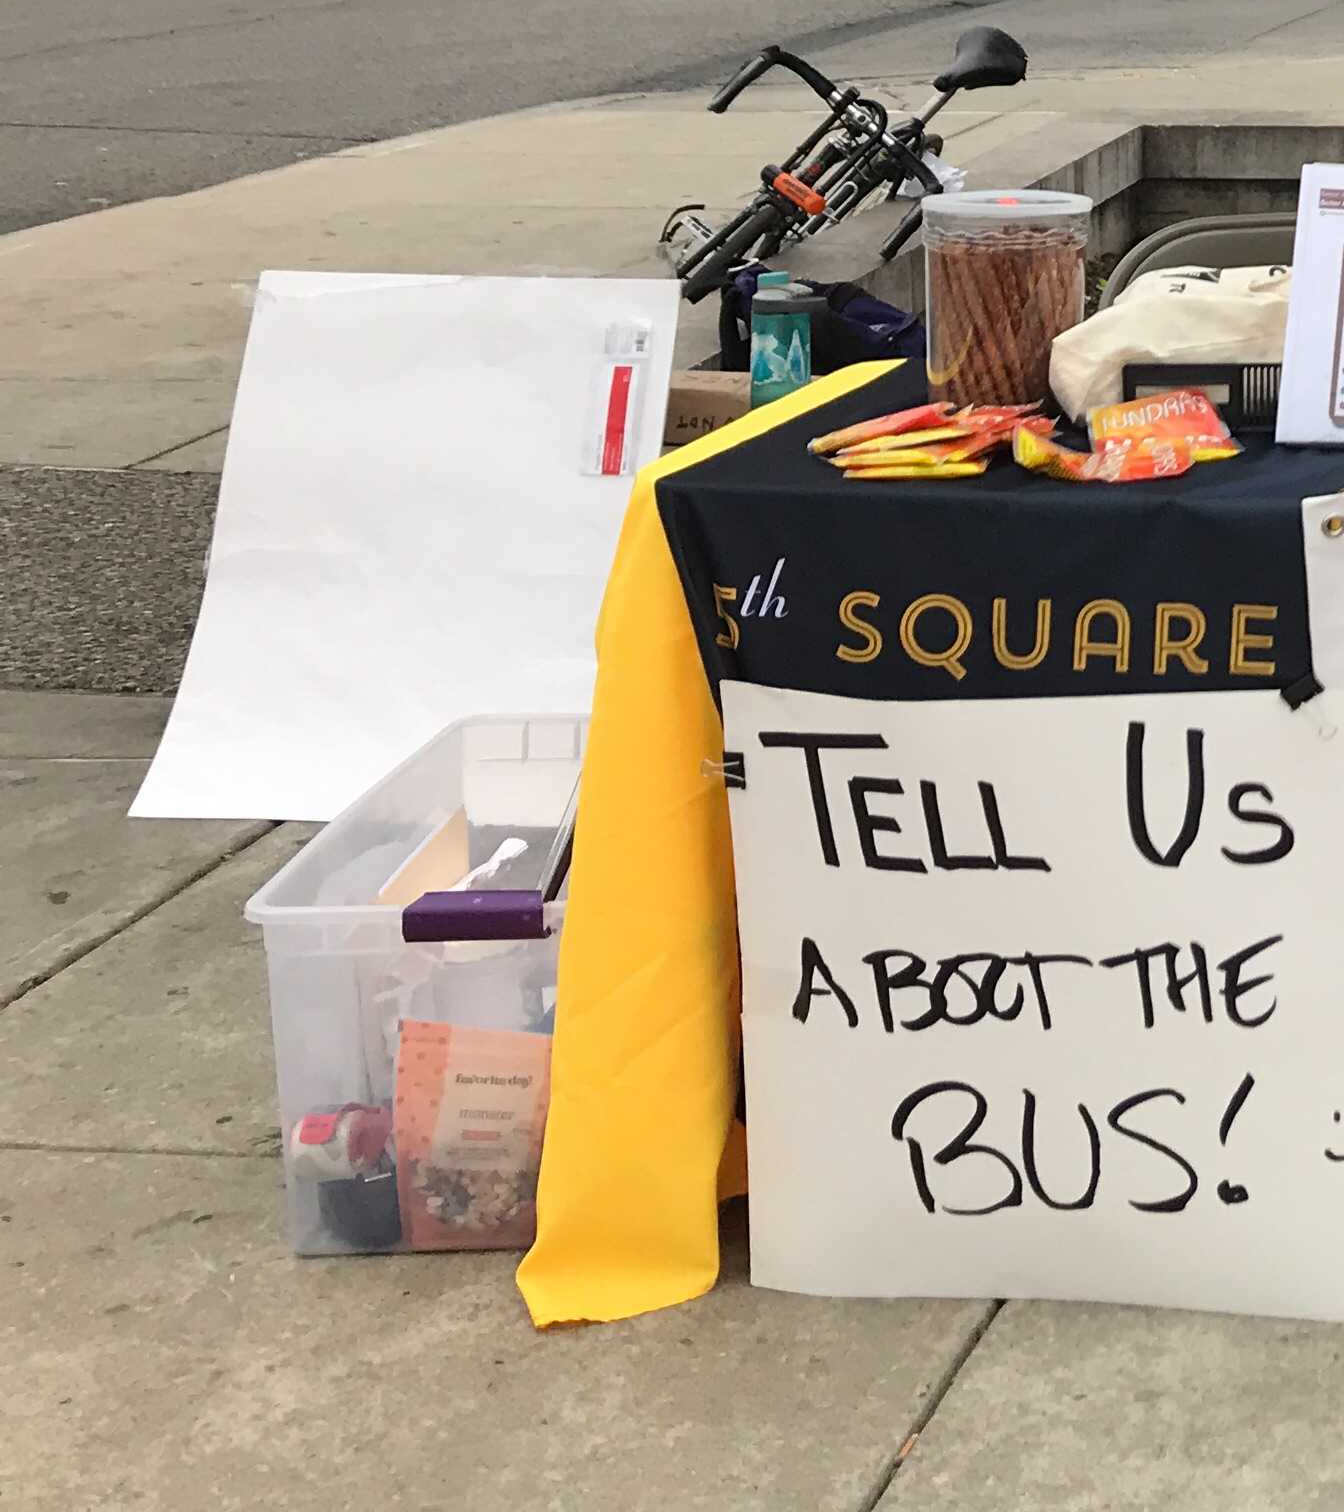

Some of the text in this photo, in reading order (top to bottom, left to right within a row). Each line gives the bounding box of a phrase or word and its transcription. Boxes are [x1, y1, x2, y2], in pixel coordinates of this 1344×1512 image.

[713, 557, 1279, 681] 5th SQUARE
[758, 731, 1051, 873] TELL
[792, 933, 1283, 1034] ABOUT THE
[891, 1071, 1255, 1215] BUS!
